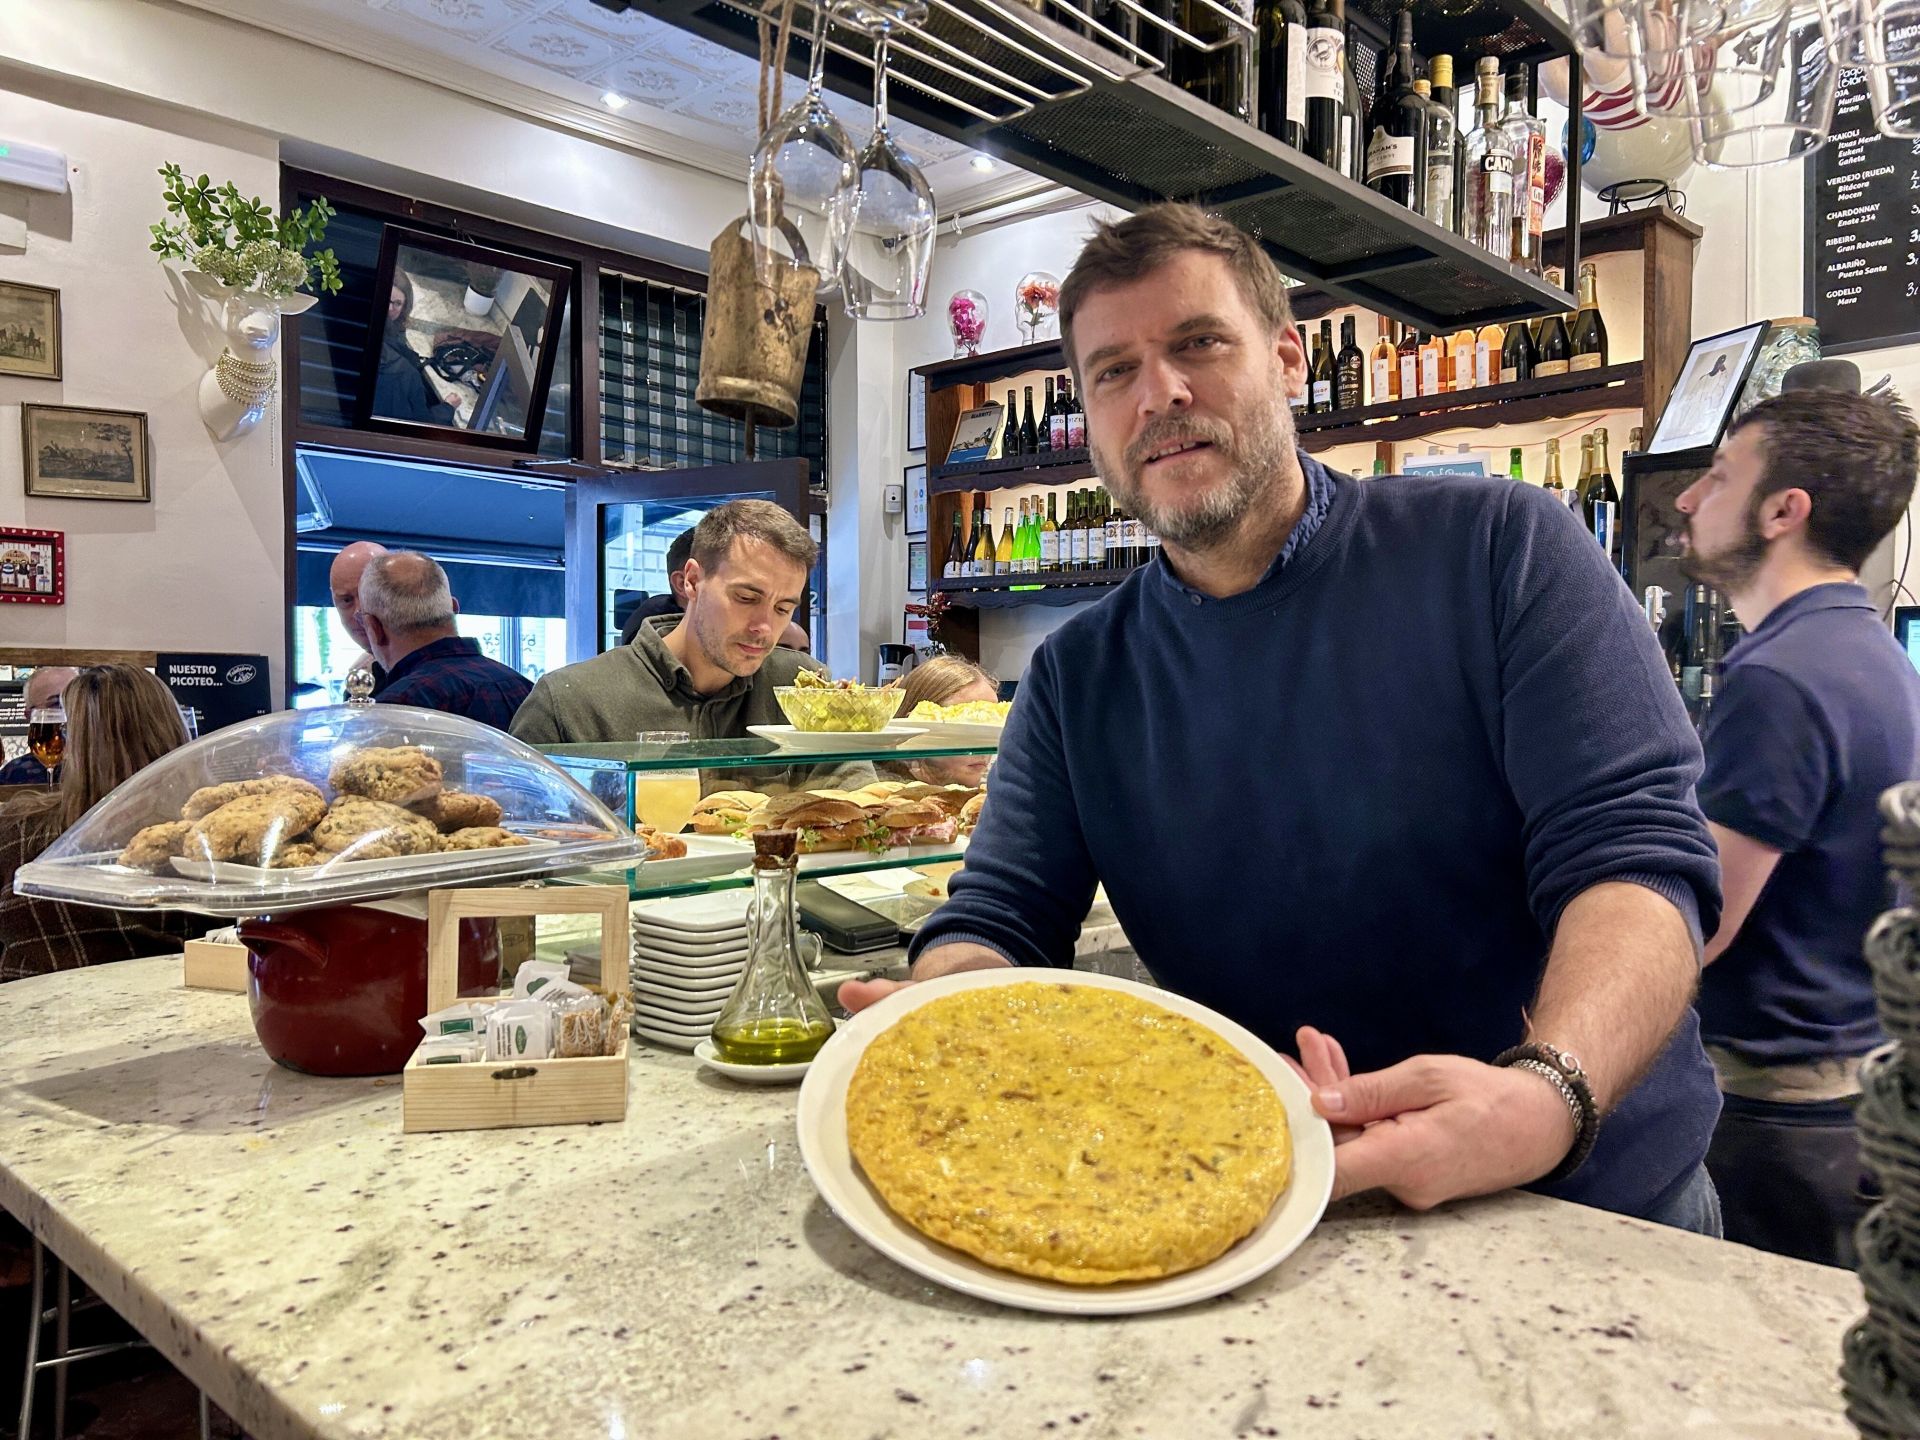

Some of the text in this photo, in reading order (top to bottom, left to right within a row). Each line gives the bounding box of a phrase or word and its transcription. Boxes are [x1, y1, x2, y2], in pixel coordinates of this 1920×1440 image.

[1838, 66, 1863, 79] Pago
[1838, 94, 1865, 106] Murillo
[1827, 128, 1860, 143] TXAKOLI
[1857, 133, 1882, 146] Mendi
[1368, 143, 1398, 157] RAHAM'S
[1837, 155, 1866, 167] Gañeta
[1826, 165, 1895, 186] VERDEJO (RUEDA)
[1837, 181, 1870, 193] Bitácora
[1837, 191, 1863, 202] Mocen
[1826, 203, 1880, 220] CHARDONNAY
[1837, 213, 1876, 228] Enate 234
[1825, 234, 1857, 247] RIBEIRO
[1836, 237, 1893, 253] Gran Reboreda
[1826, 258, 1866, 273] ALBARIÑO
[1837, 265, 1888, 280] Puerta Santa
[1826, 286, 1862, 299] GODELLO
[169, 664, 217, 675] NUESTRO
[170, 677, 223, 687] PICOTEO...
